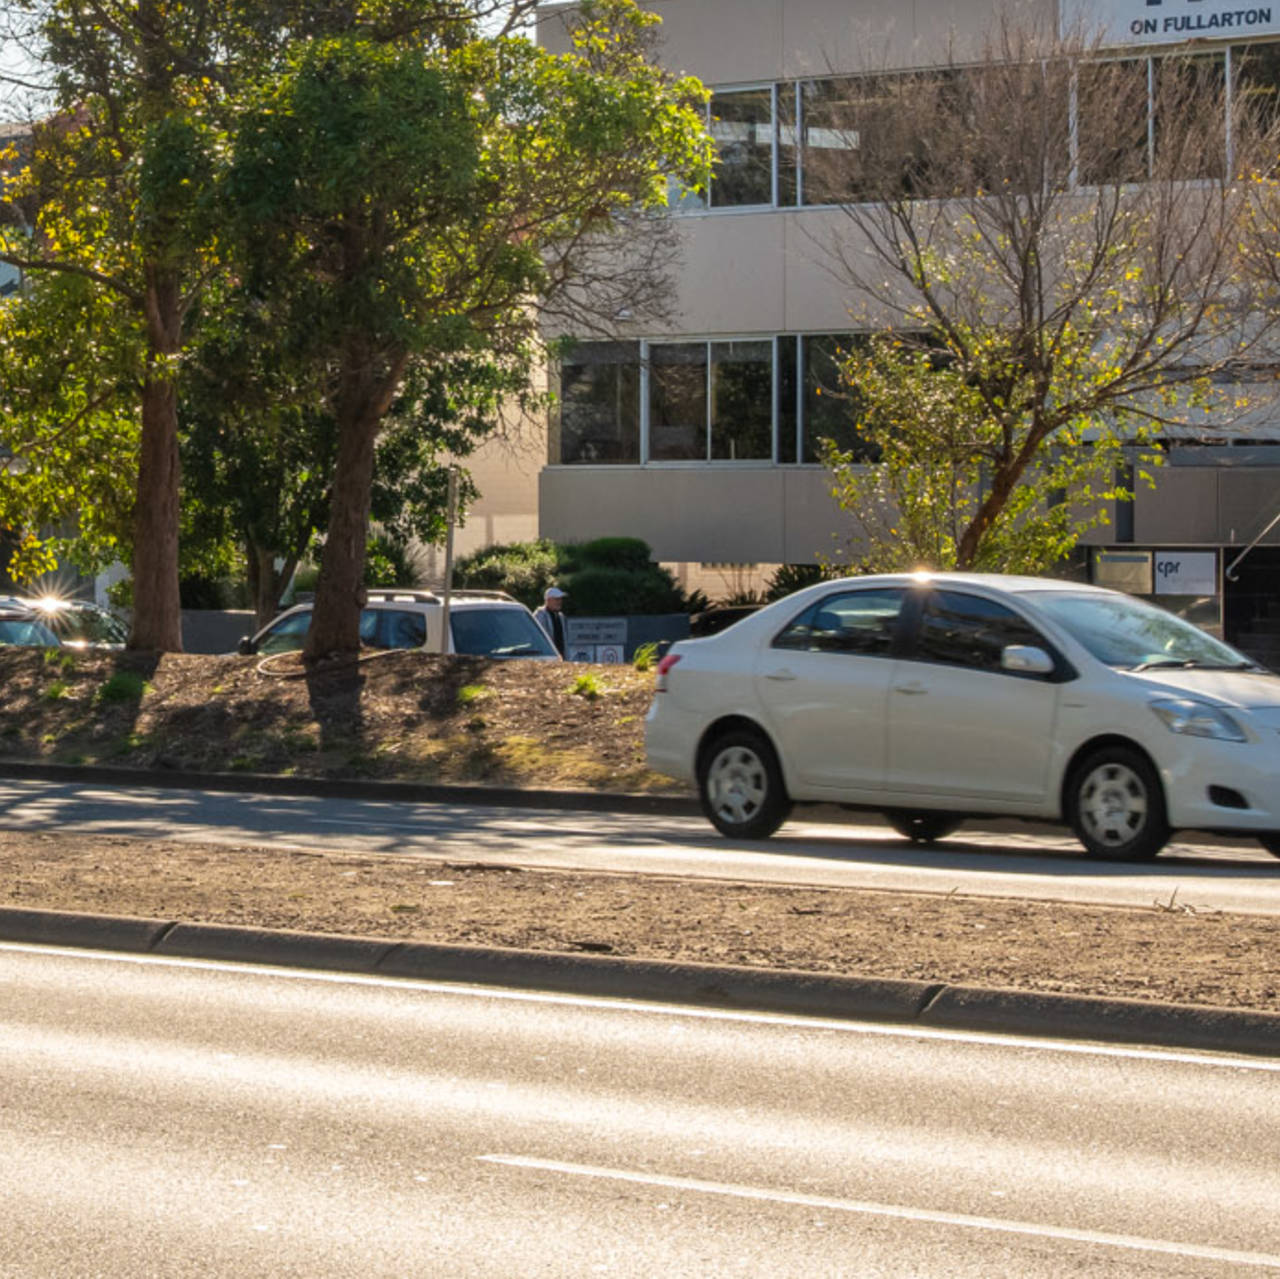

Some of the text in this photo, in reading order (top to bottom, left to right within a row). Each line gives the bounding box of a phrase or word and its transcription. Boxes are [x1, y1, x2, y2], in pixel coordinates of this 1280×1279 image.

[1130, 7, 1272, 35] ON FULLARTON
[1157, 561, 1181, 578] cpr
